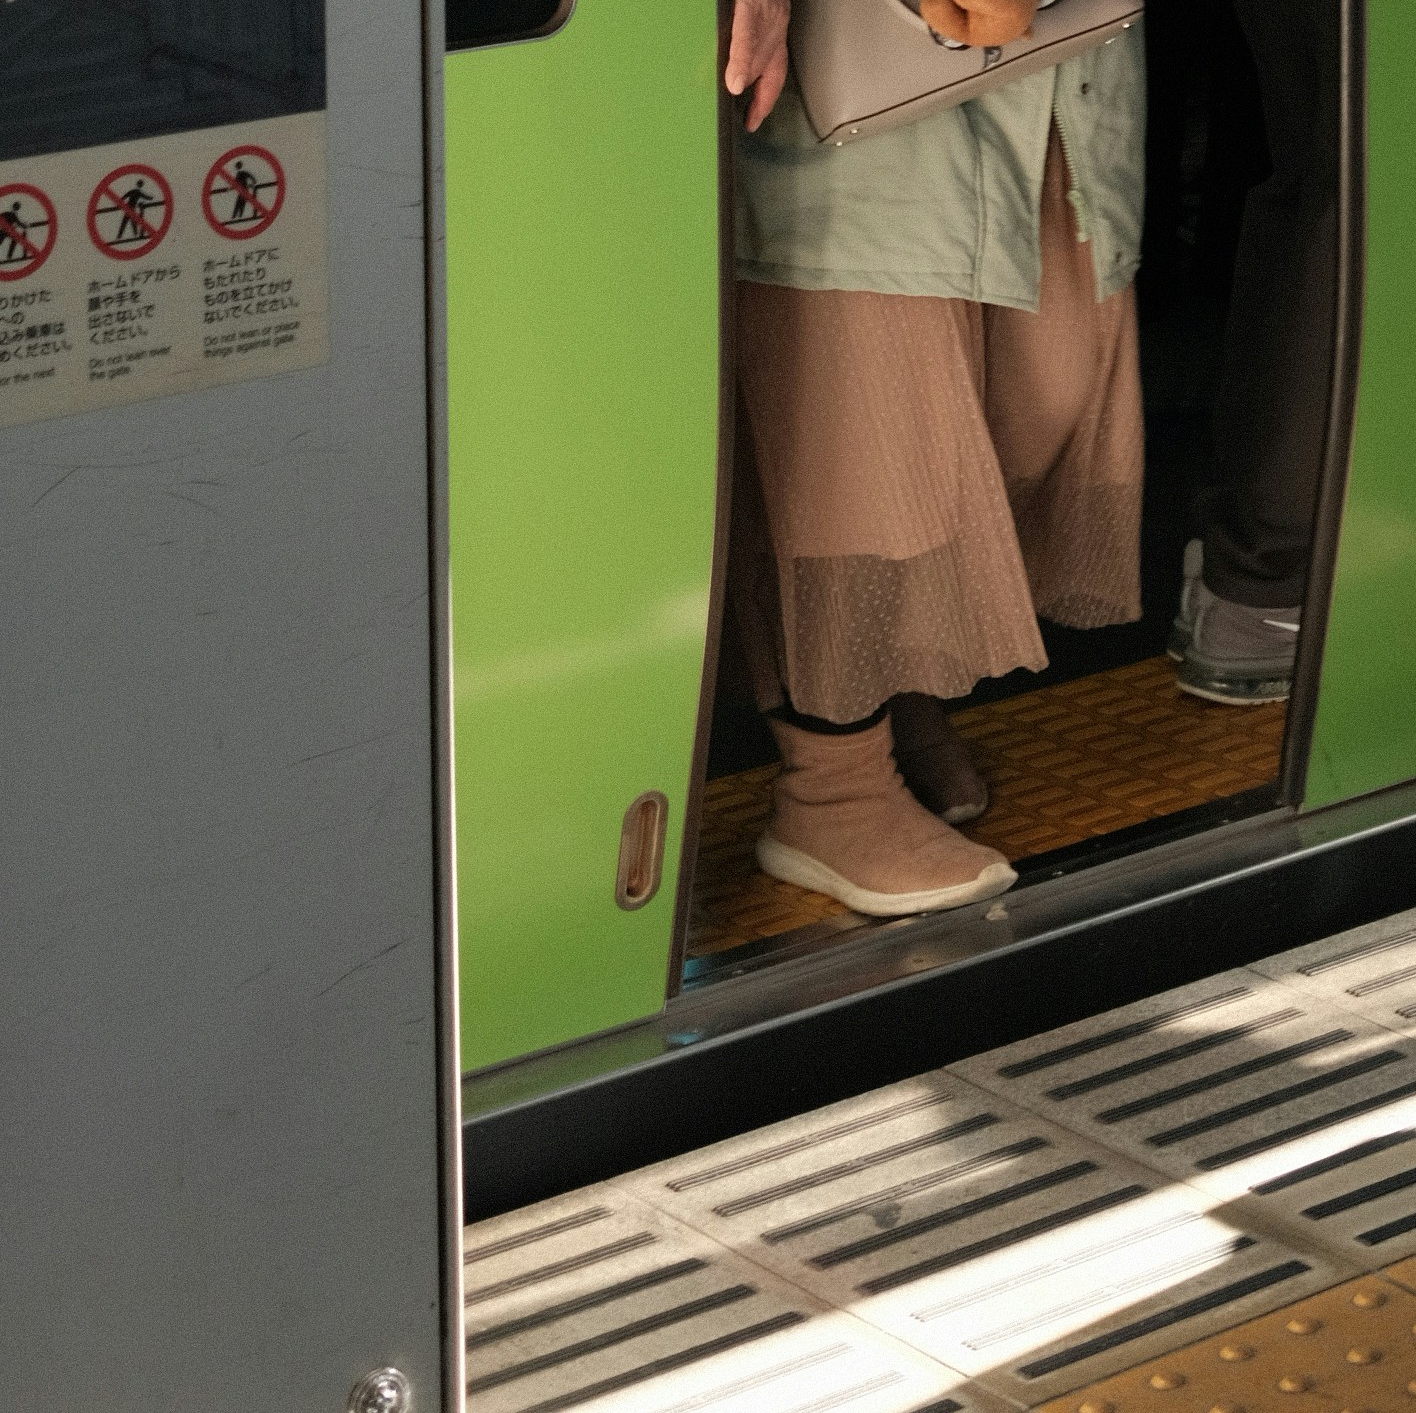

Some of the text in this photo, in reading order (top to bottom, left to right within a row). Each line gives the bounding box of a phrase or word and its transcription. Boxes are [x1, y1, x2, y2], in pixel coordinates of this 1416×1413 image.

[203, 247, 280, 273] ホームドアに
[88, 265, 181, 294] ホームドアから
[204, 267, 266, 290] もたれたり
[204, 279, 293, 307] ものを立てかけ
